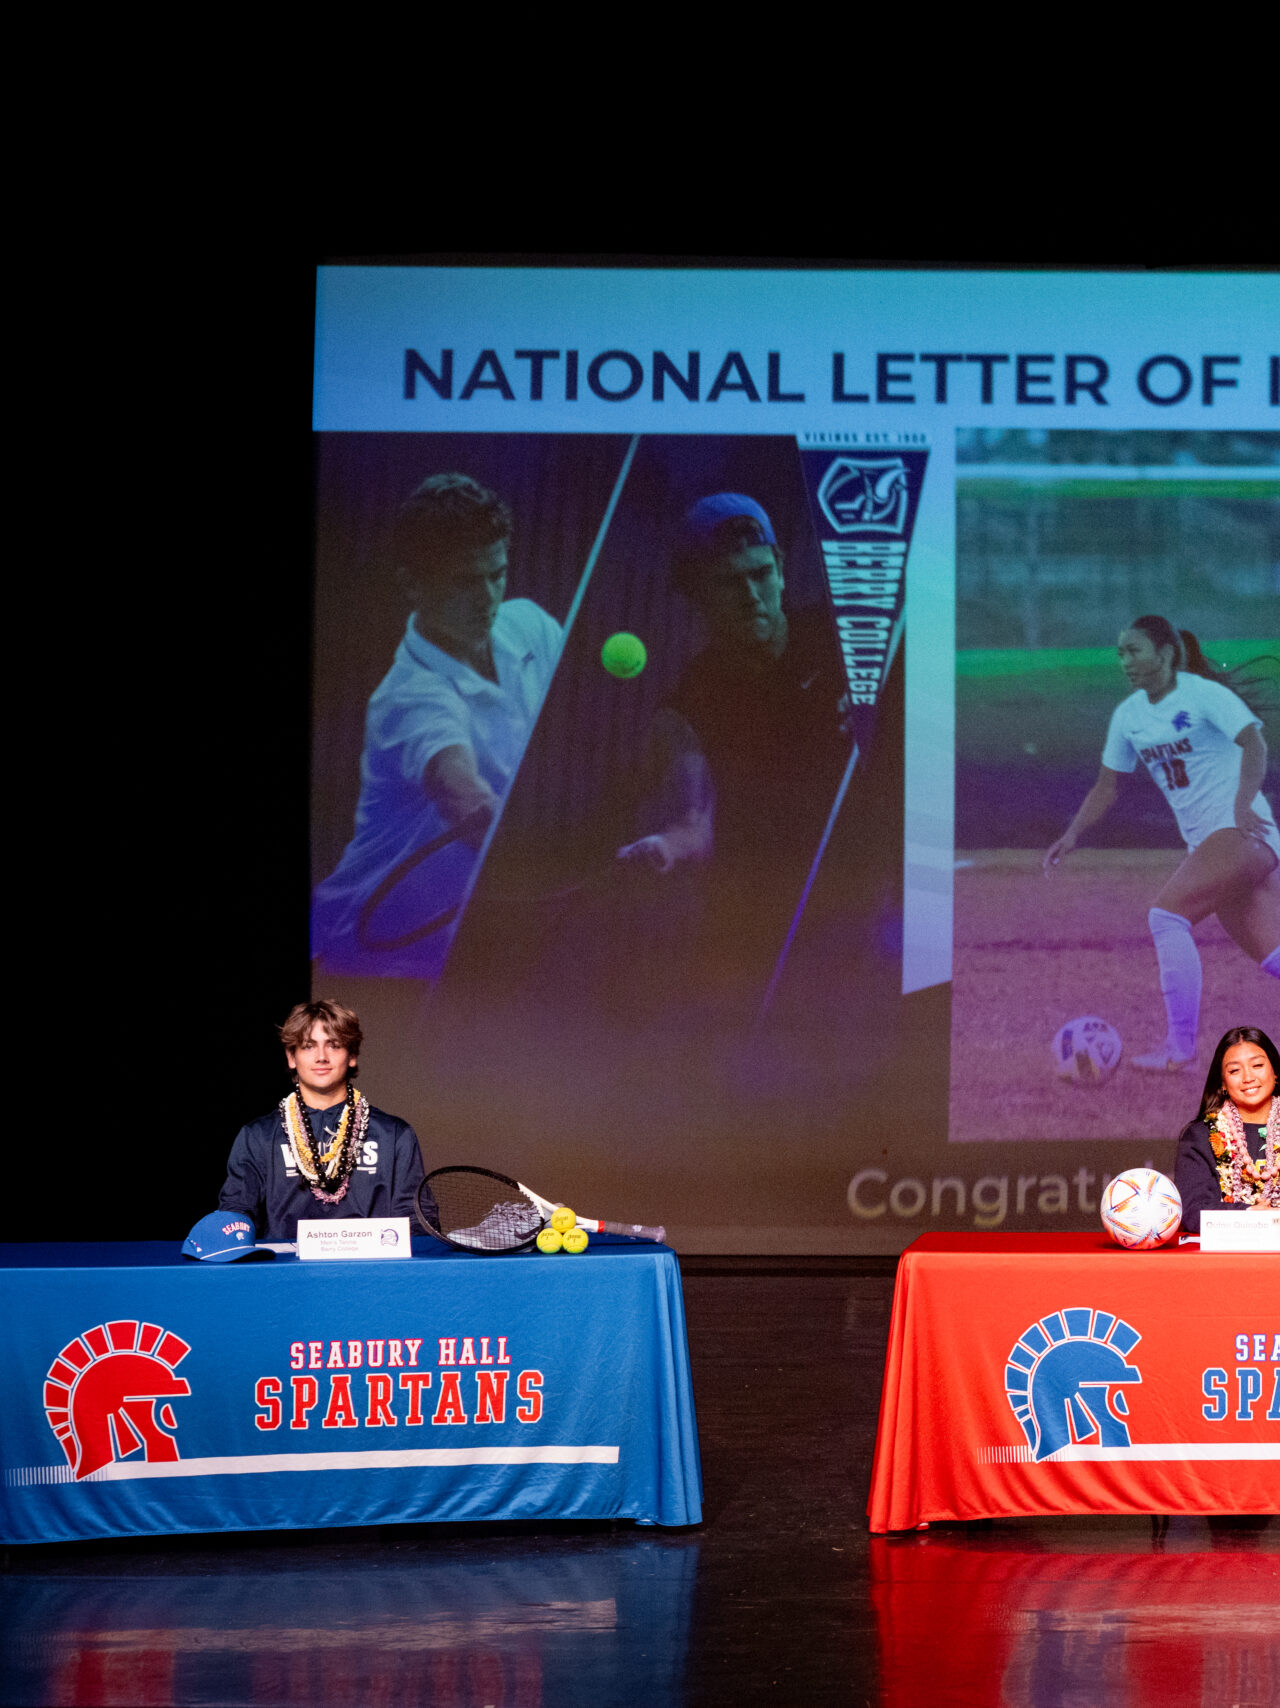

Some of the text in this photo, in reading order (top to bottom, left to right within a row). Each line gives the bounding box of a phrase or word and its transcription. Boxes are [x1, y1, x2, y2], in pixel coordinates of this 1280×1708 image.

[404, 349, 805, 402] NATIONAL
[832, 352, 1110, 405] LETTER
[1137, 354, 1242, 407] OF
[821, 540, 907, 705] BERRY COLLEGE
[306, 1230, 373, 1239] Ashton Garzon
[289, 1336, 512, 1370] SEABURY HALL
[254, 1369, 545, 1431] SPARTANS
